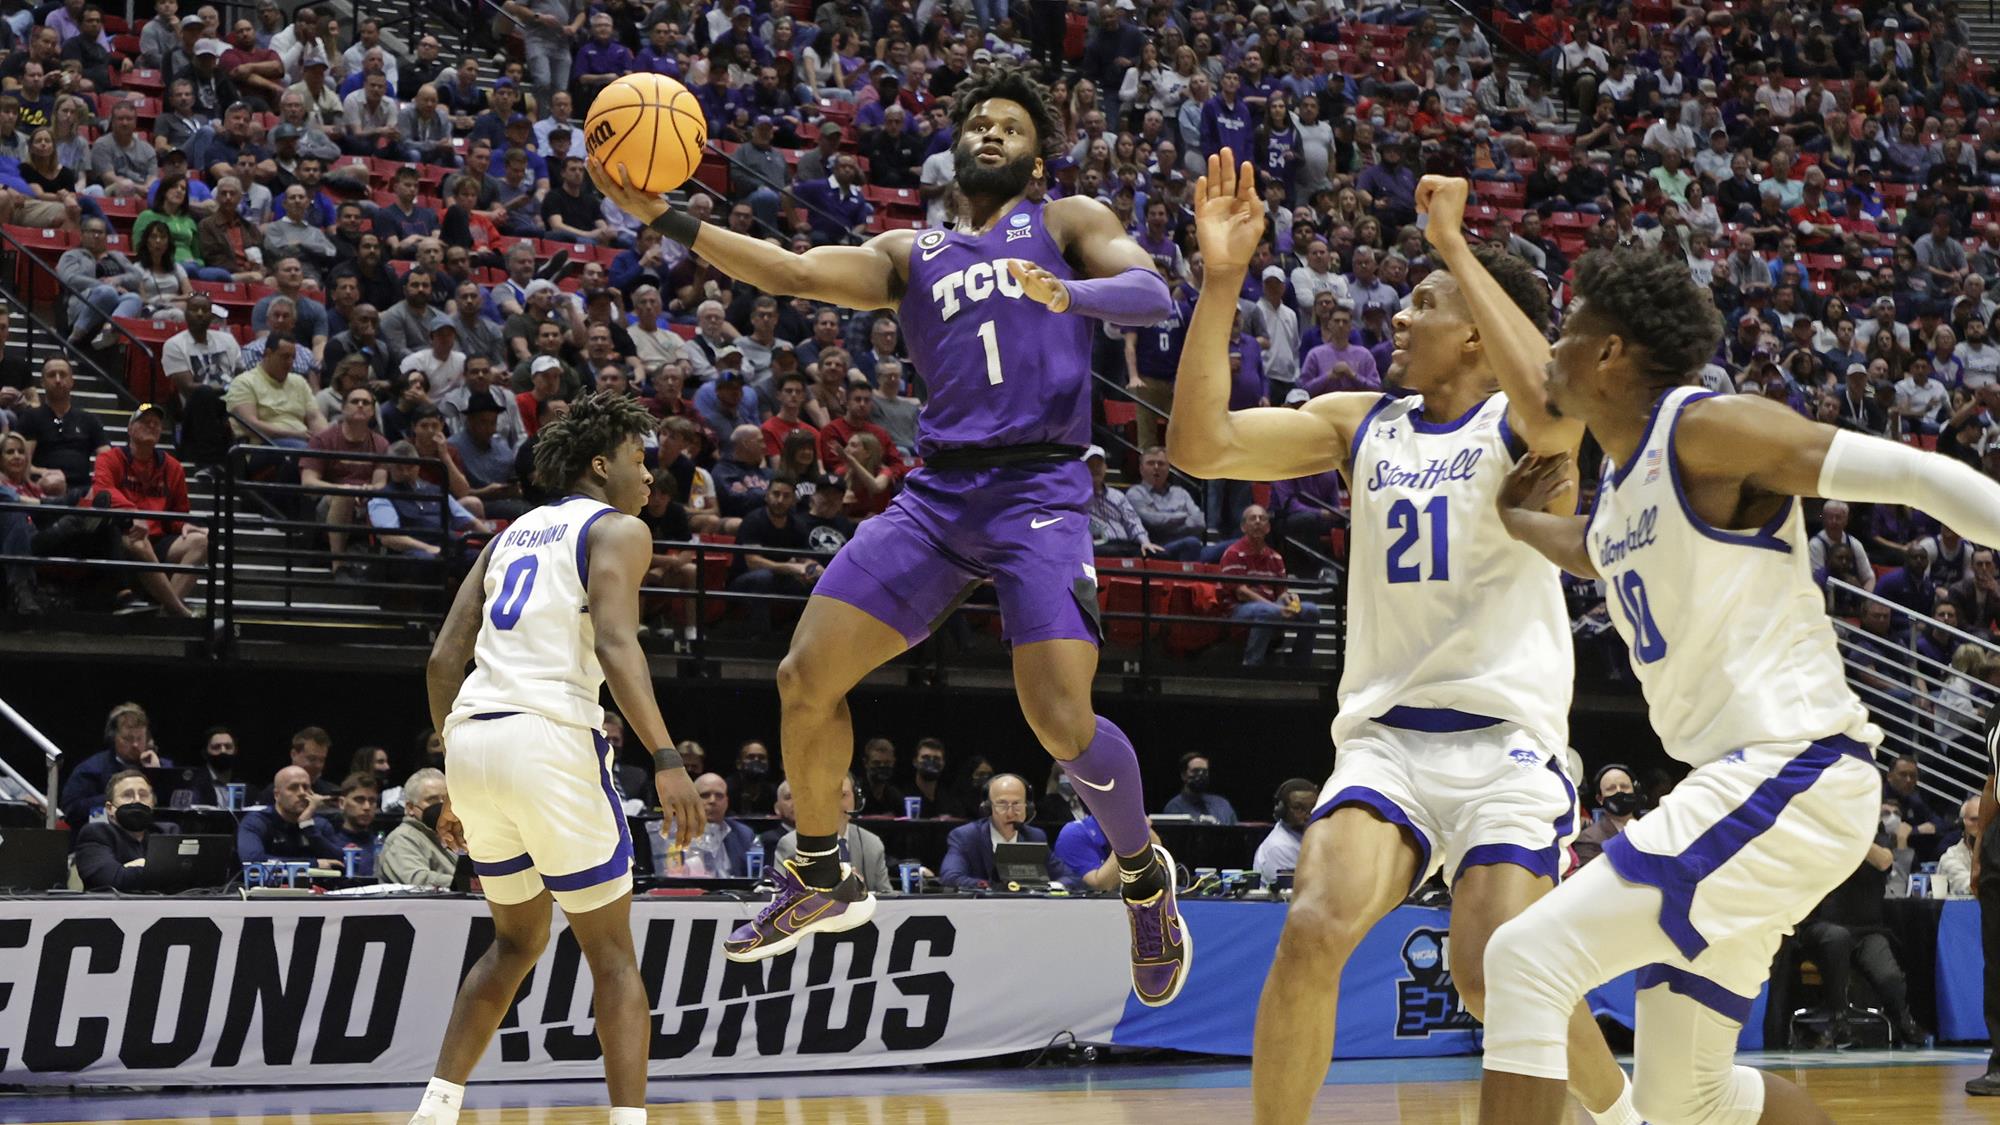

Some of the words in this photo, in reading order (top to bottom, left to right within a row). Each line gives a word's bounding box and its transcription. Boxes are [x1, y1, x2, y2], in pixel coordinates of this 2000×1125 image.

[1268, 151, 1286, 169] 54
[932, 258, 1029, 321] TCU
[977, 320, 1004, 385] 1
[1368, 460, 1421, 491] Ston
[1387, 495, 1449, 583] 21
[490, 554, 538, 630] 0
